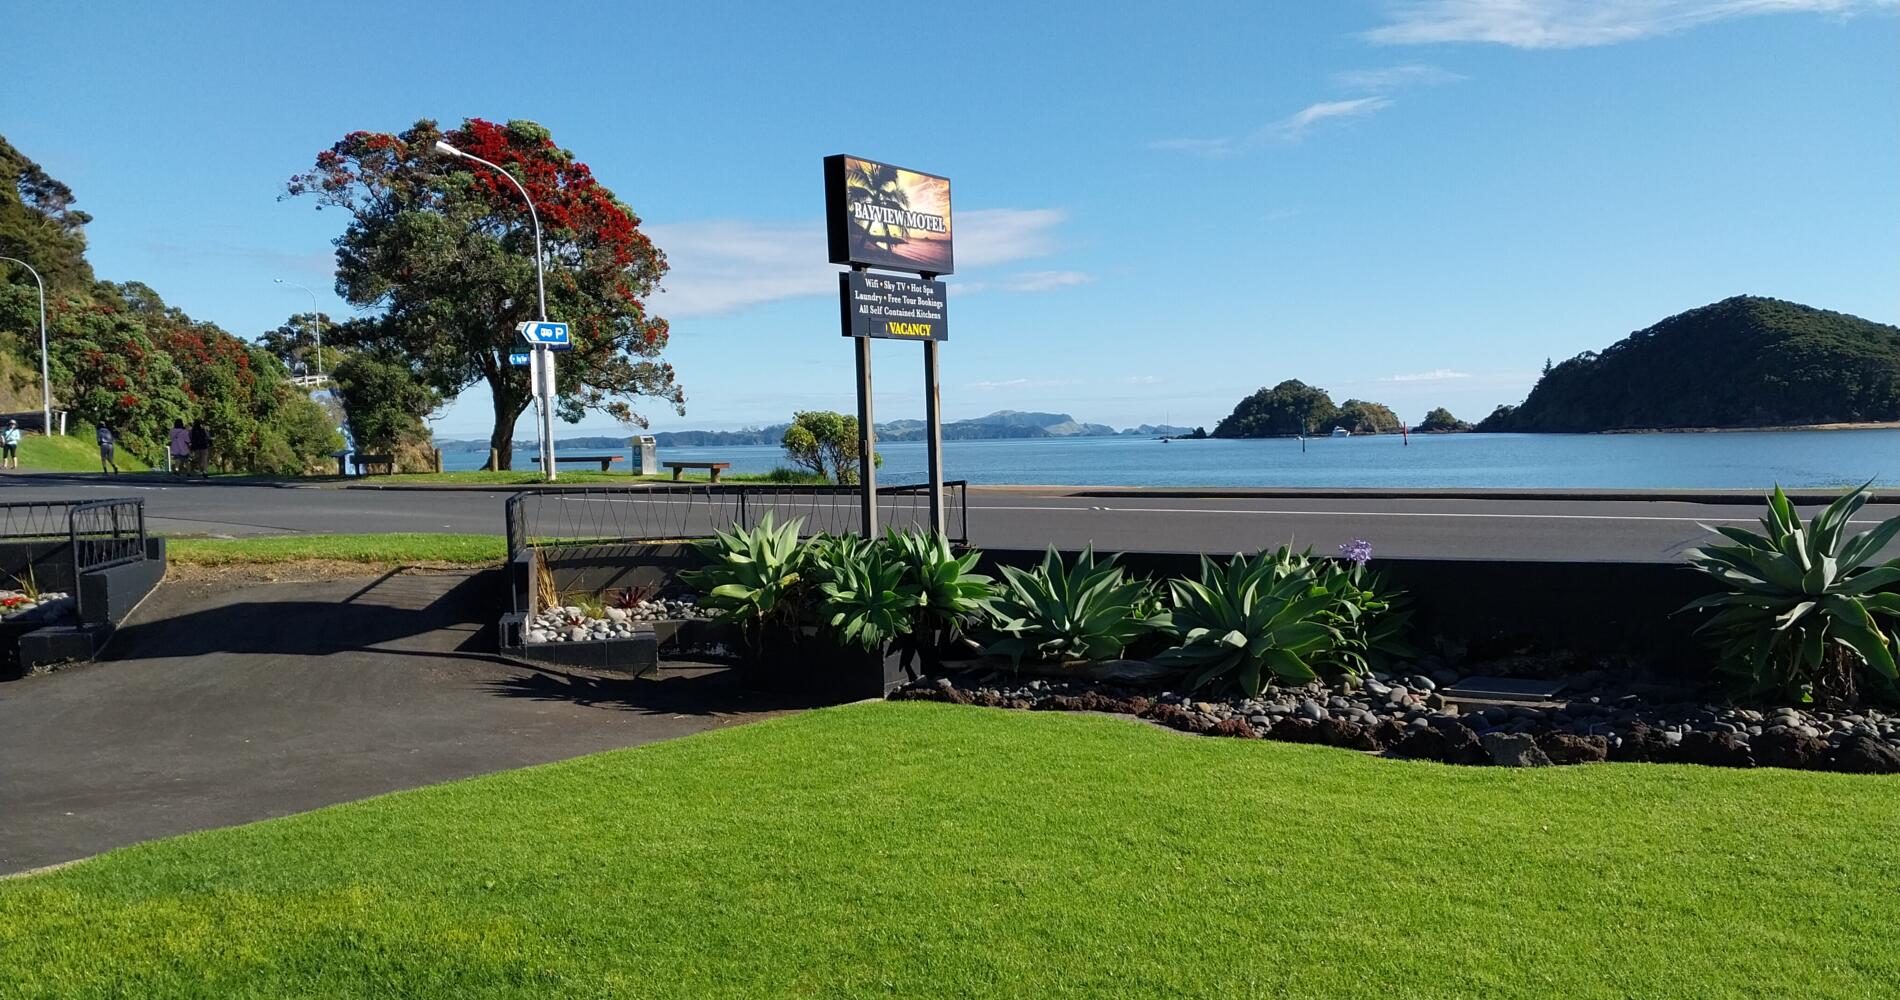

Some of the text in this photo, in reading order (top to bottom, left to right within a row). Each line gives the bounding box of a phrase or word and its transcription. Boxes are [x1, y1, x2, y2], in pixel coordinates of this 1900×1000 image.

[855, 202, 945, 232] BAYVIEW MOTEL
[865, 279, 934, 295] Wifi Sky TV Hot Spa
[855, 290, 943, 309] Laundry Free Tour Bookings
[859, 303, 941, 319] All Self Contained Kitchens
[555, 327, 563, 339] P
[889, 322, 931, 336] VACANCY
